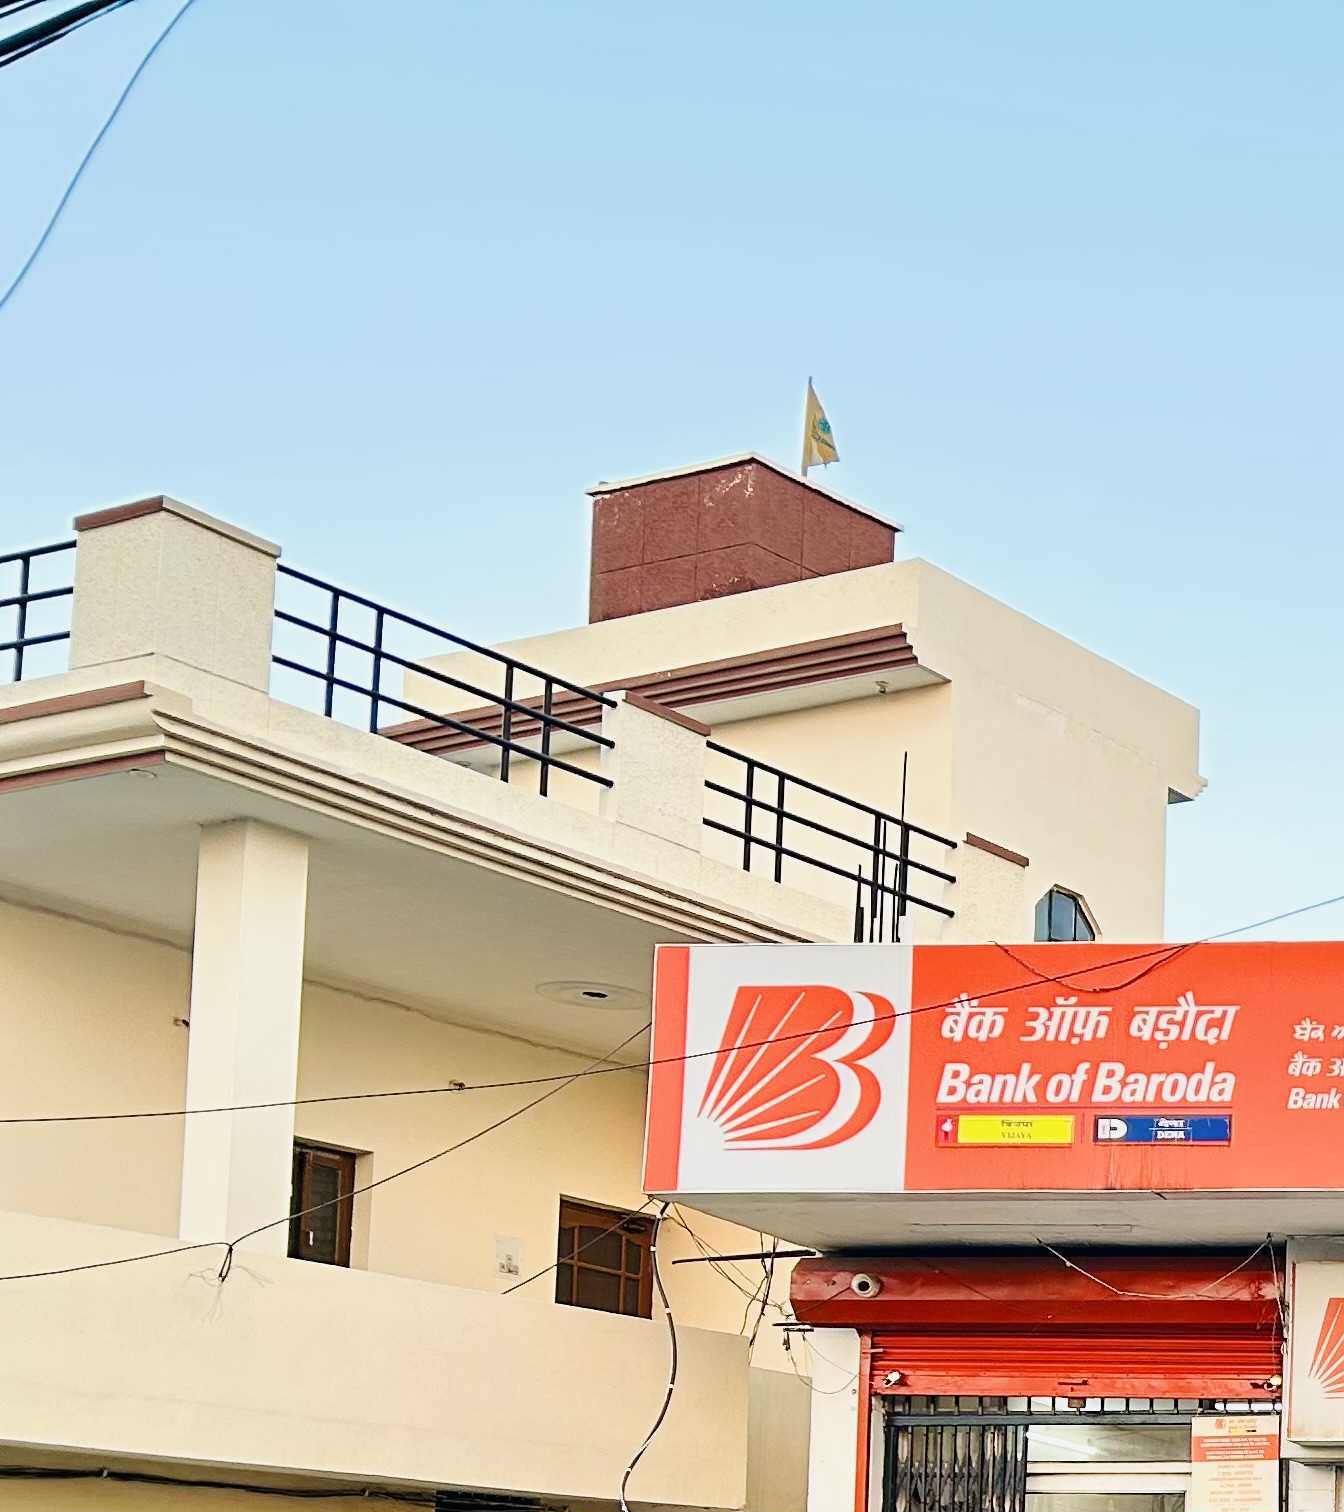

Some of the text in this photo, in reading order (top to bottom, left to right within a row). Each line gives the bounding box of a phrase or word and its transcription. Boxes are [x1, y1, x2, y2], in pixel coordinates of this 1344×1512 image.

[941, 992, 1008, 1042] बैंक
[1129, 991, 1240, 1049] बड़ौदा
[1288, 1051, 1323, 1077] बैंक
[936, 1061, 1236, 1104] Bank of Baroda
[1287, 1088, 1342, 1109] Bank
